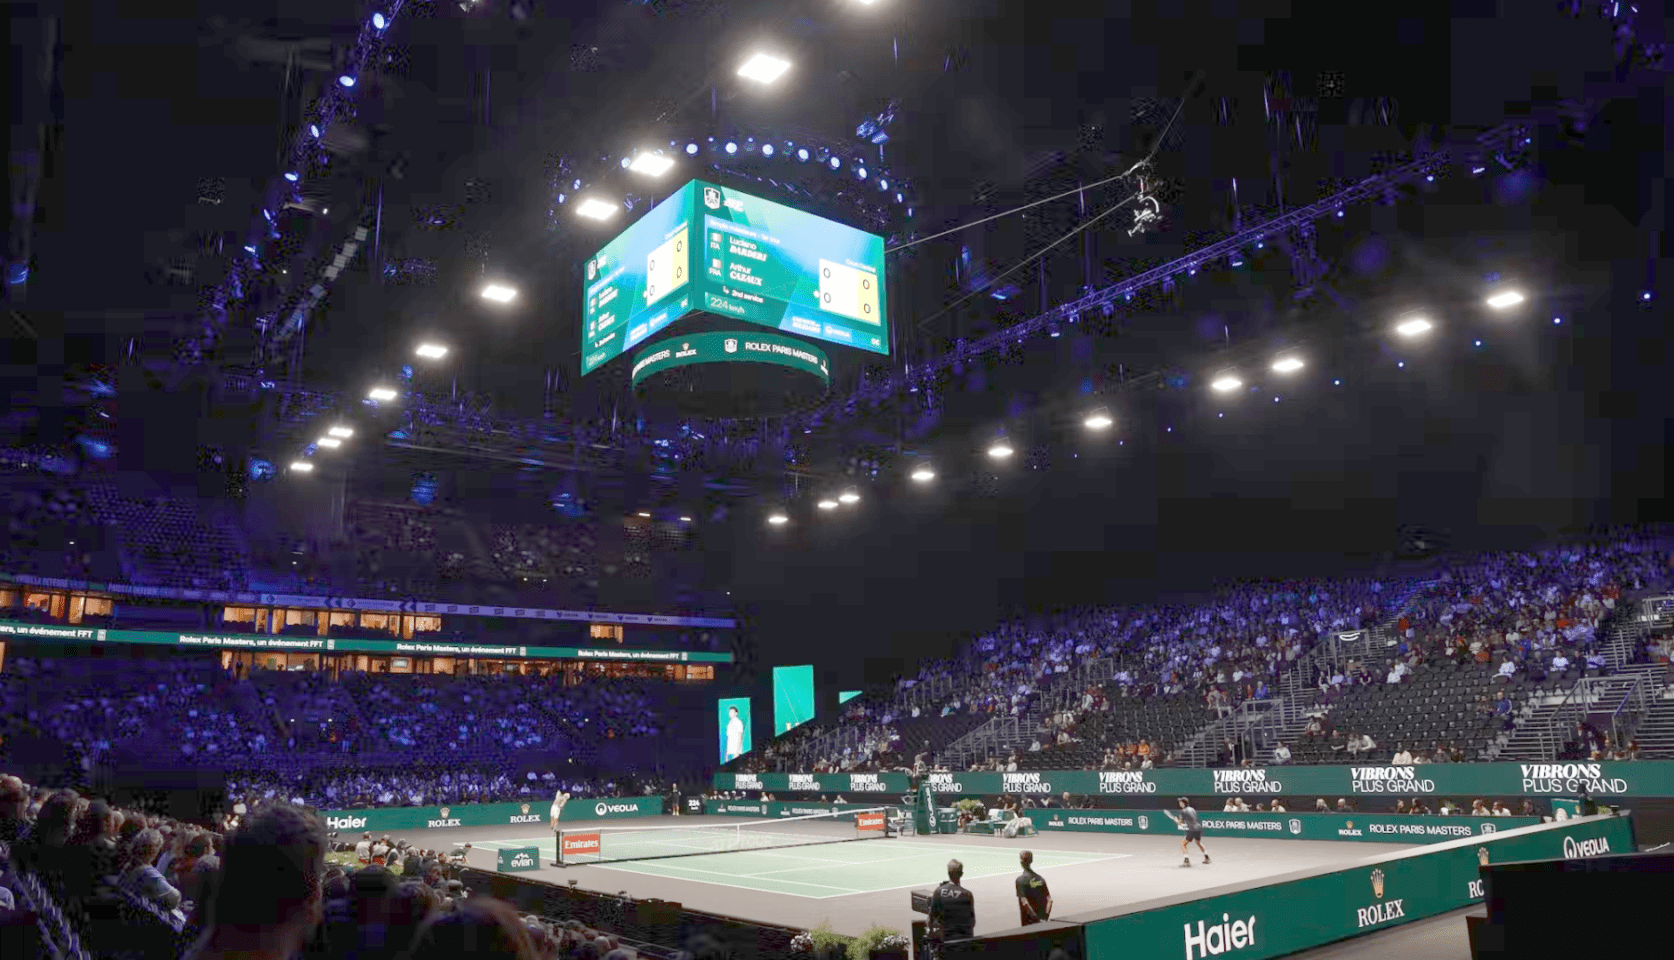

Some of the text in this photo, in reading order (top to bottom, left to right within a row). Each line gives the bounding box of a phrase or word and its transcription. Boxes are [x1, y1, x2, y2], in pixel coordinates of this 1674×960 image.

[729, 236, 757, 251] Luciano
[729, 262, 752, 274] Arthur
[823, 267, 831, 279] 0
[729, 270, 763, 287] CAZAUX
[862, 279, 870, 290] 0
[710, 296, 729, 309] 224
[823, 292, 832, 304] 0
[863, 303, 871, 314] 0
[745, 341, 818, 365] ROLEX PARIS MASTERS
[17, 626, 28, 634] un
[29, 627, 76, 637] événement
[77, 629, 93, 638] FFT
[179, 635, 201, 644] Rolex
[202, 636, 222, 645] Paris
[222, 637, 256, 647] Masters,
[268, 639, 309, 648] événement
[309, 640, 324, 648] FFT
[396, 643, 416, 651] Rolex
[416, 644, 433, 652] Paris
[433, 645, 461, 653] Masters,
[1099, 771, 1143, 783] VIBRONS
[1213, 769, 1266, 782] VIBRONS
[1350, 766, 1415, 781] VIBRONS
[1521, 763, 1602, 779] VIBRONS
[788, 773, 814, 782] VIBRONS
[850, 773, 878, 783] VIBRONS
[1002, 772, 1041, 783] VIBRONS
[788, 782, 821, 791] PLUS GRAND
[850, 783, 887, 792] PLUS GRAND
[937, 782, 963, 793] GRAND
[1002, 782, 1052, 793] PLUS GRAND
[1100, 781, 1157, 793] PLUS GRAND
[1214, 781, 1282, 793] PLUS GRAND
[1352, 779, 1435, 793] PLUS GRAND
[1522, 778, 1563, 793] PLUS
[607, 803, 639, 813] VEOLIA
[326, 815, 367, 829] Haier
[428, 818, 461, 828] ROLEX
[510, 815, 541, 823] ROLEX
[857, 818, 884, 828] Emirates
[1068, 816, 1133, 826] ROLEX PARIS MASTERS
[1202, 820, 1282, 830] ROLEX PARIS MASTERS
[1369, 823, 1472, 836] ROLEX PARIS MASTERS
[564, 839, 599, 849] Emirates
[1576, 836, 1610, 858] VEOLIA
[511, 858, 534, 868] evian
[940, 888, 962, 899] EA7
[1357, 899, 1405, 928] ROLEX
[1183, 912, 1256, 960] Haier
